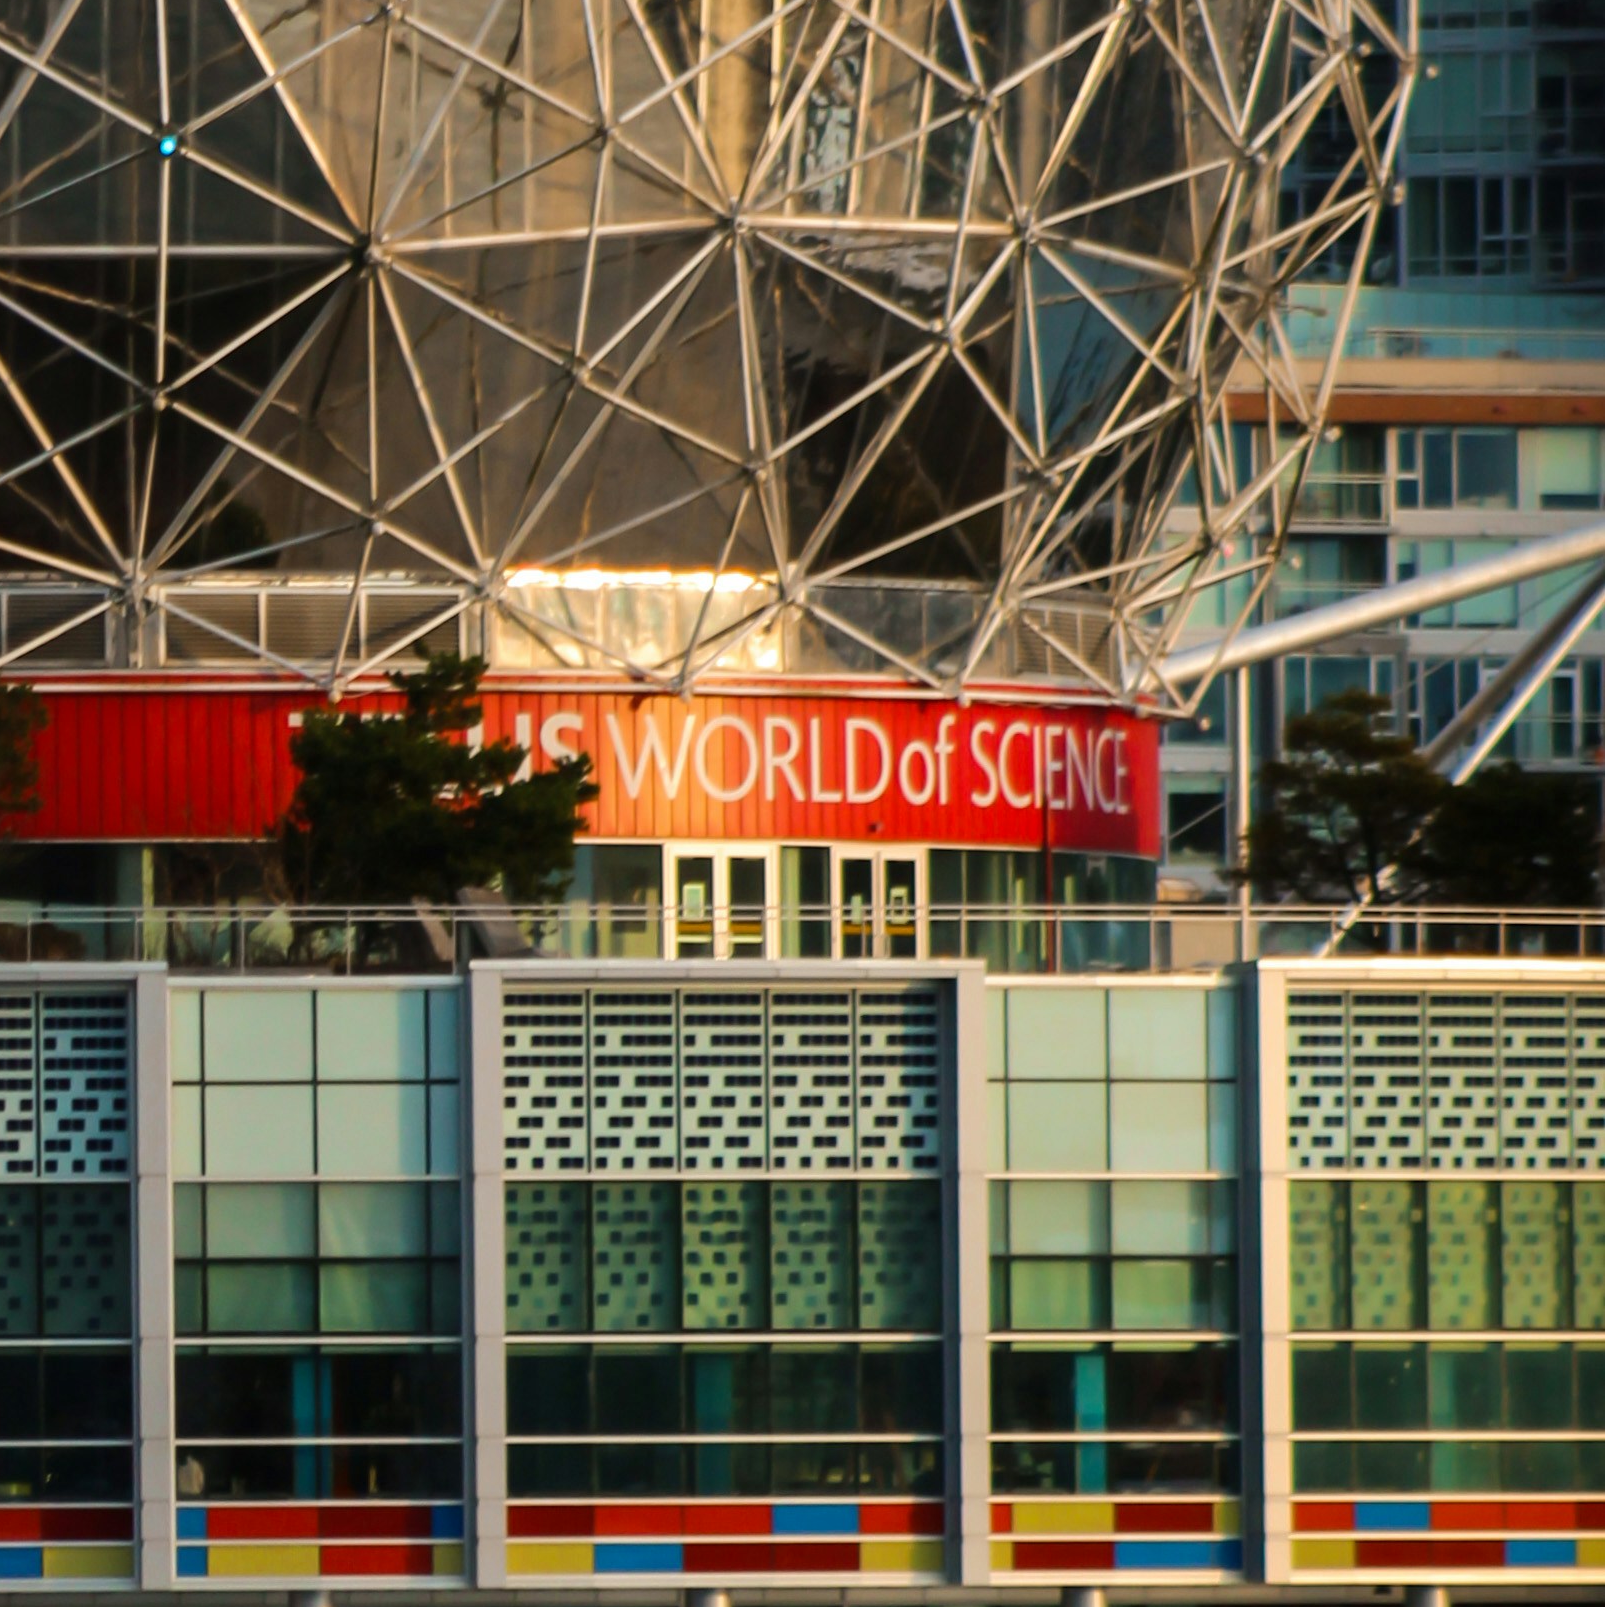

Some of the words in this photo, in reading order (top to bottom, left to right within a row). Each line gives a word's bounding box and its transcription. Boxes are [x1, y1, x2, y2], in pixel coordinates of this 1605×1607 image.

[605, 712, 893, 804] WORLD
[898, 713, 957, 807] of
[969, 719, 1131, 816] SCIENCE
